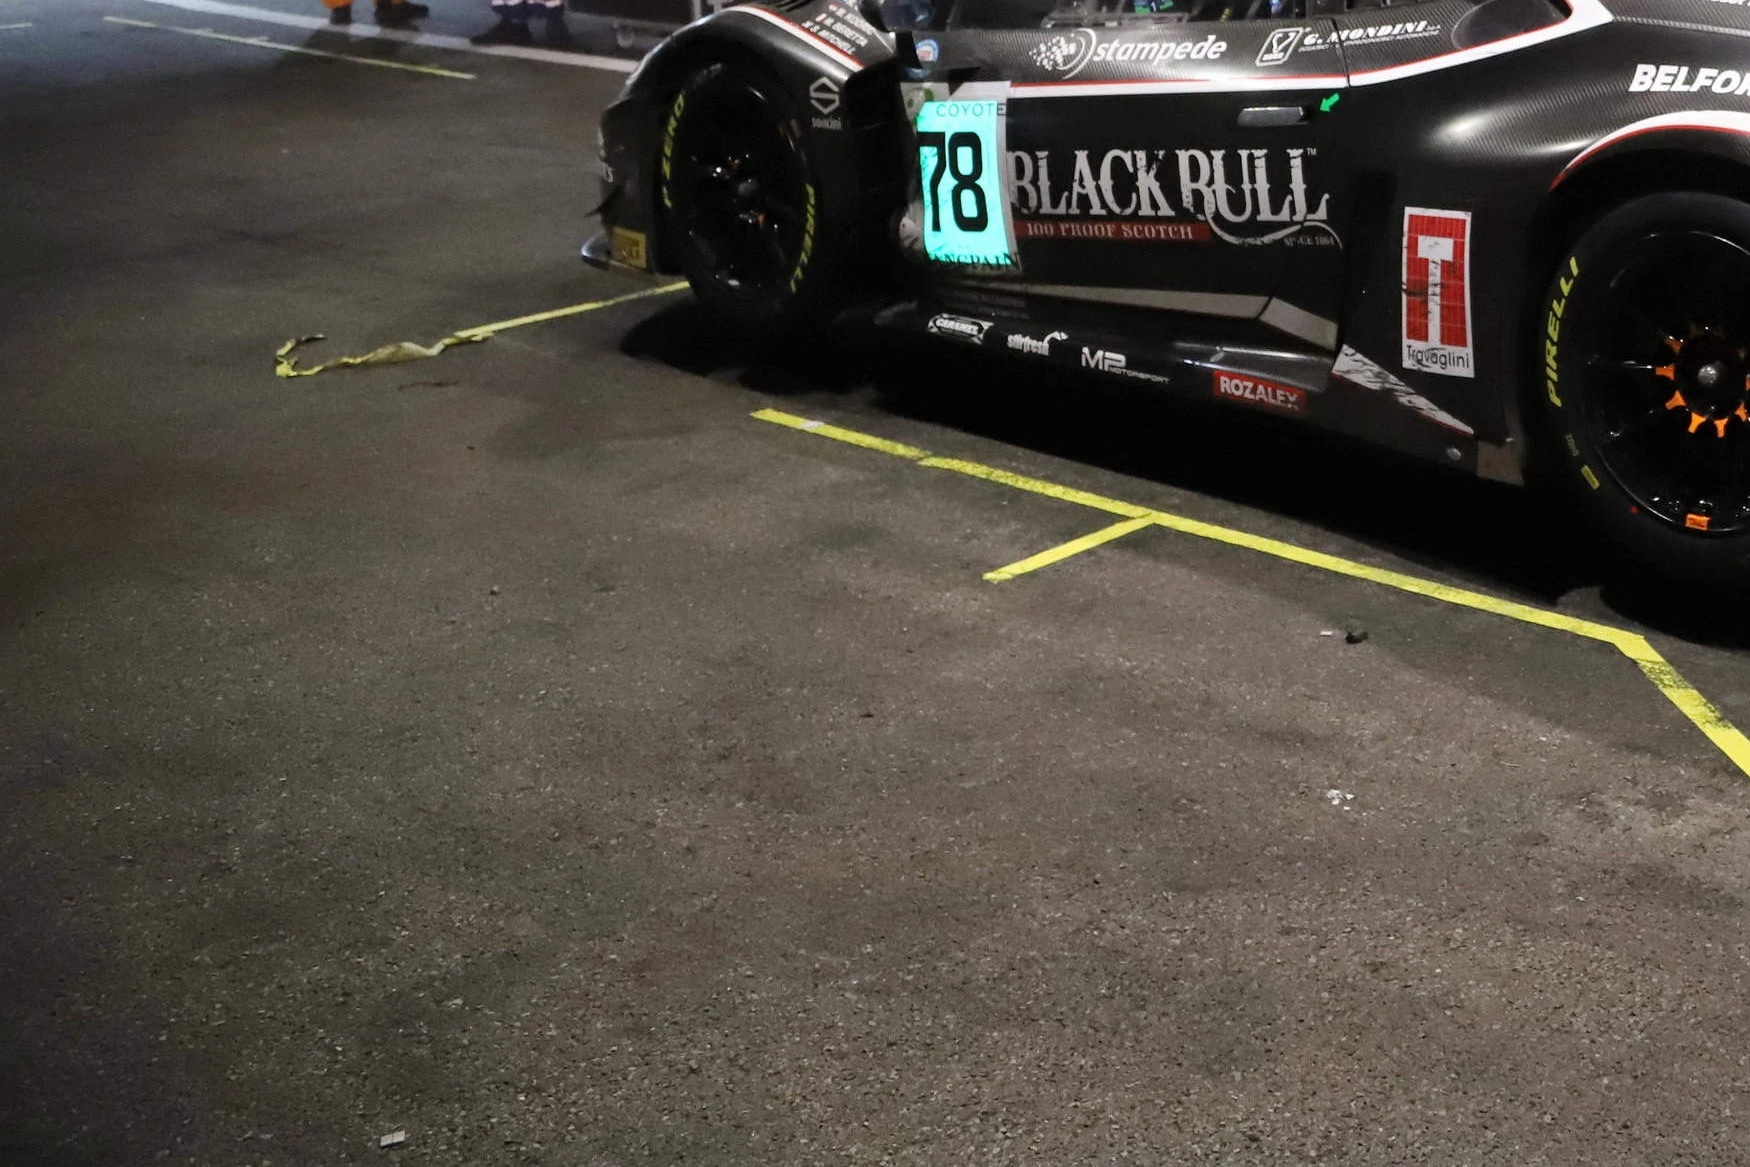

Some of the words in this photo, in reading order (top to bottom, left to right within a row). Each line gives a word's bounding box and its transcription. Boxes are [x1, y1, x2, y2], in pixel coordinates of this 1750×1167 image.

[1303, 33, 1323, 46] G.
[1326, 20, 1428, 44] MONDINI
[1093, 34, 1227, 66] stampede
[936, 102, 1008, 118] COYOTE
[916, 130, 989, 233] 78
[1005, 148, 1176, 217] BLACK
[1174, 147, 1330, 223] BULL
[1027, 221, 1054, 236] 100
[1060, 222, 1116, 237] PROOF
[1121, 224, 1194, 239] SCOTCH
[1545, 256, 1579, 408] PIRELLI
[1081, 346, 1127, 371] MP
[1405, 344, 1471, 370] Travaglini
[1109, 365, 1170, 383] MOTORSPORT
[1219, 375, 1300, 411] ROZALEX
